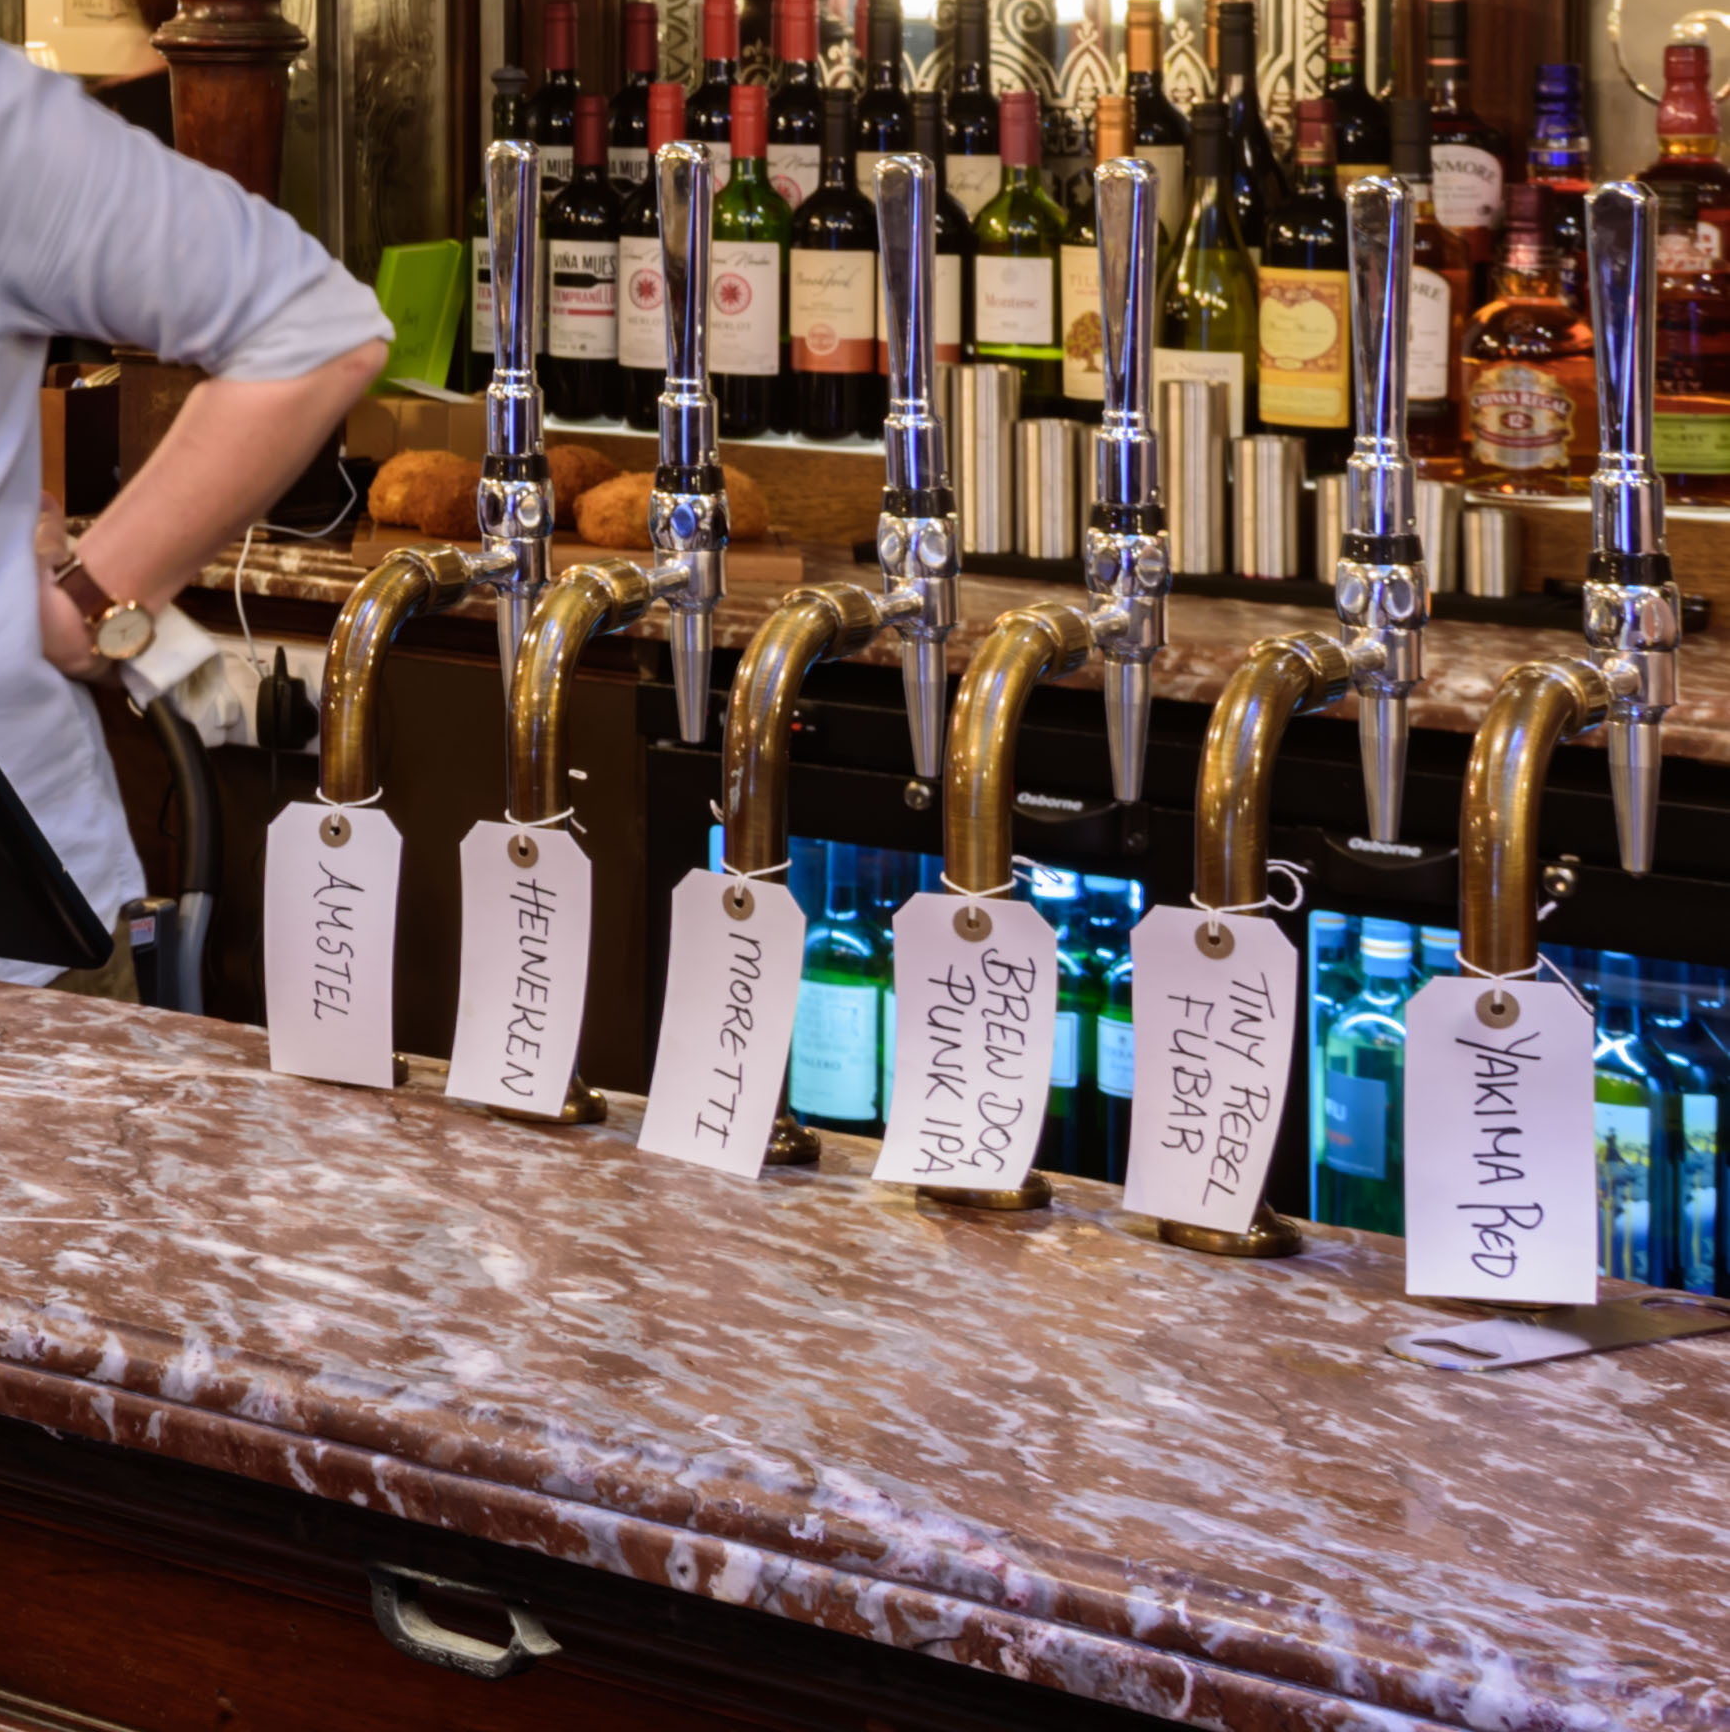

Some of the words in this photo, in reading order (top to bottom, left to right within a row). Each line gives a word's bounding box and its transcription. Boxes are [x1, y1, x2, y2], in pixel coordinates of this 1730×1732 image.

[553, 252, 578, 269] VIÑA
[1471, 392, 1516, 408] CHIVAS
[1520, 392, 1569, 415] REGAL
[1017, 791, 1084, 812] Osborne
[1347, 836, 1423, 858] Osborne
[314, 861, 366, 1020] AMSTEL
[925, 963, 977, 1100] PUNK
[980, 947, 1037, 1080] BREW
[1227, 971, 1276, 1068] TINY
[1159, 993, 1214, 1157] FUBAR
[1455, 1031, 1542, 1188] YAKIMA
[912, 1115, 965, 1175] IPA
[958, 1090, 1023, 1175] DOG
[1201, 1079, 1272, 1207] REBEL
[1455, 1201, 1545, 1281] RED
